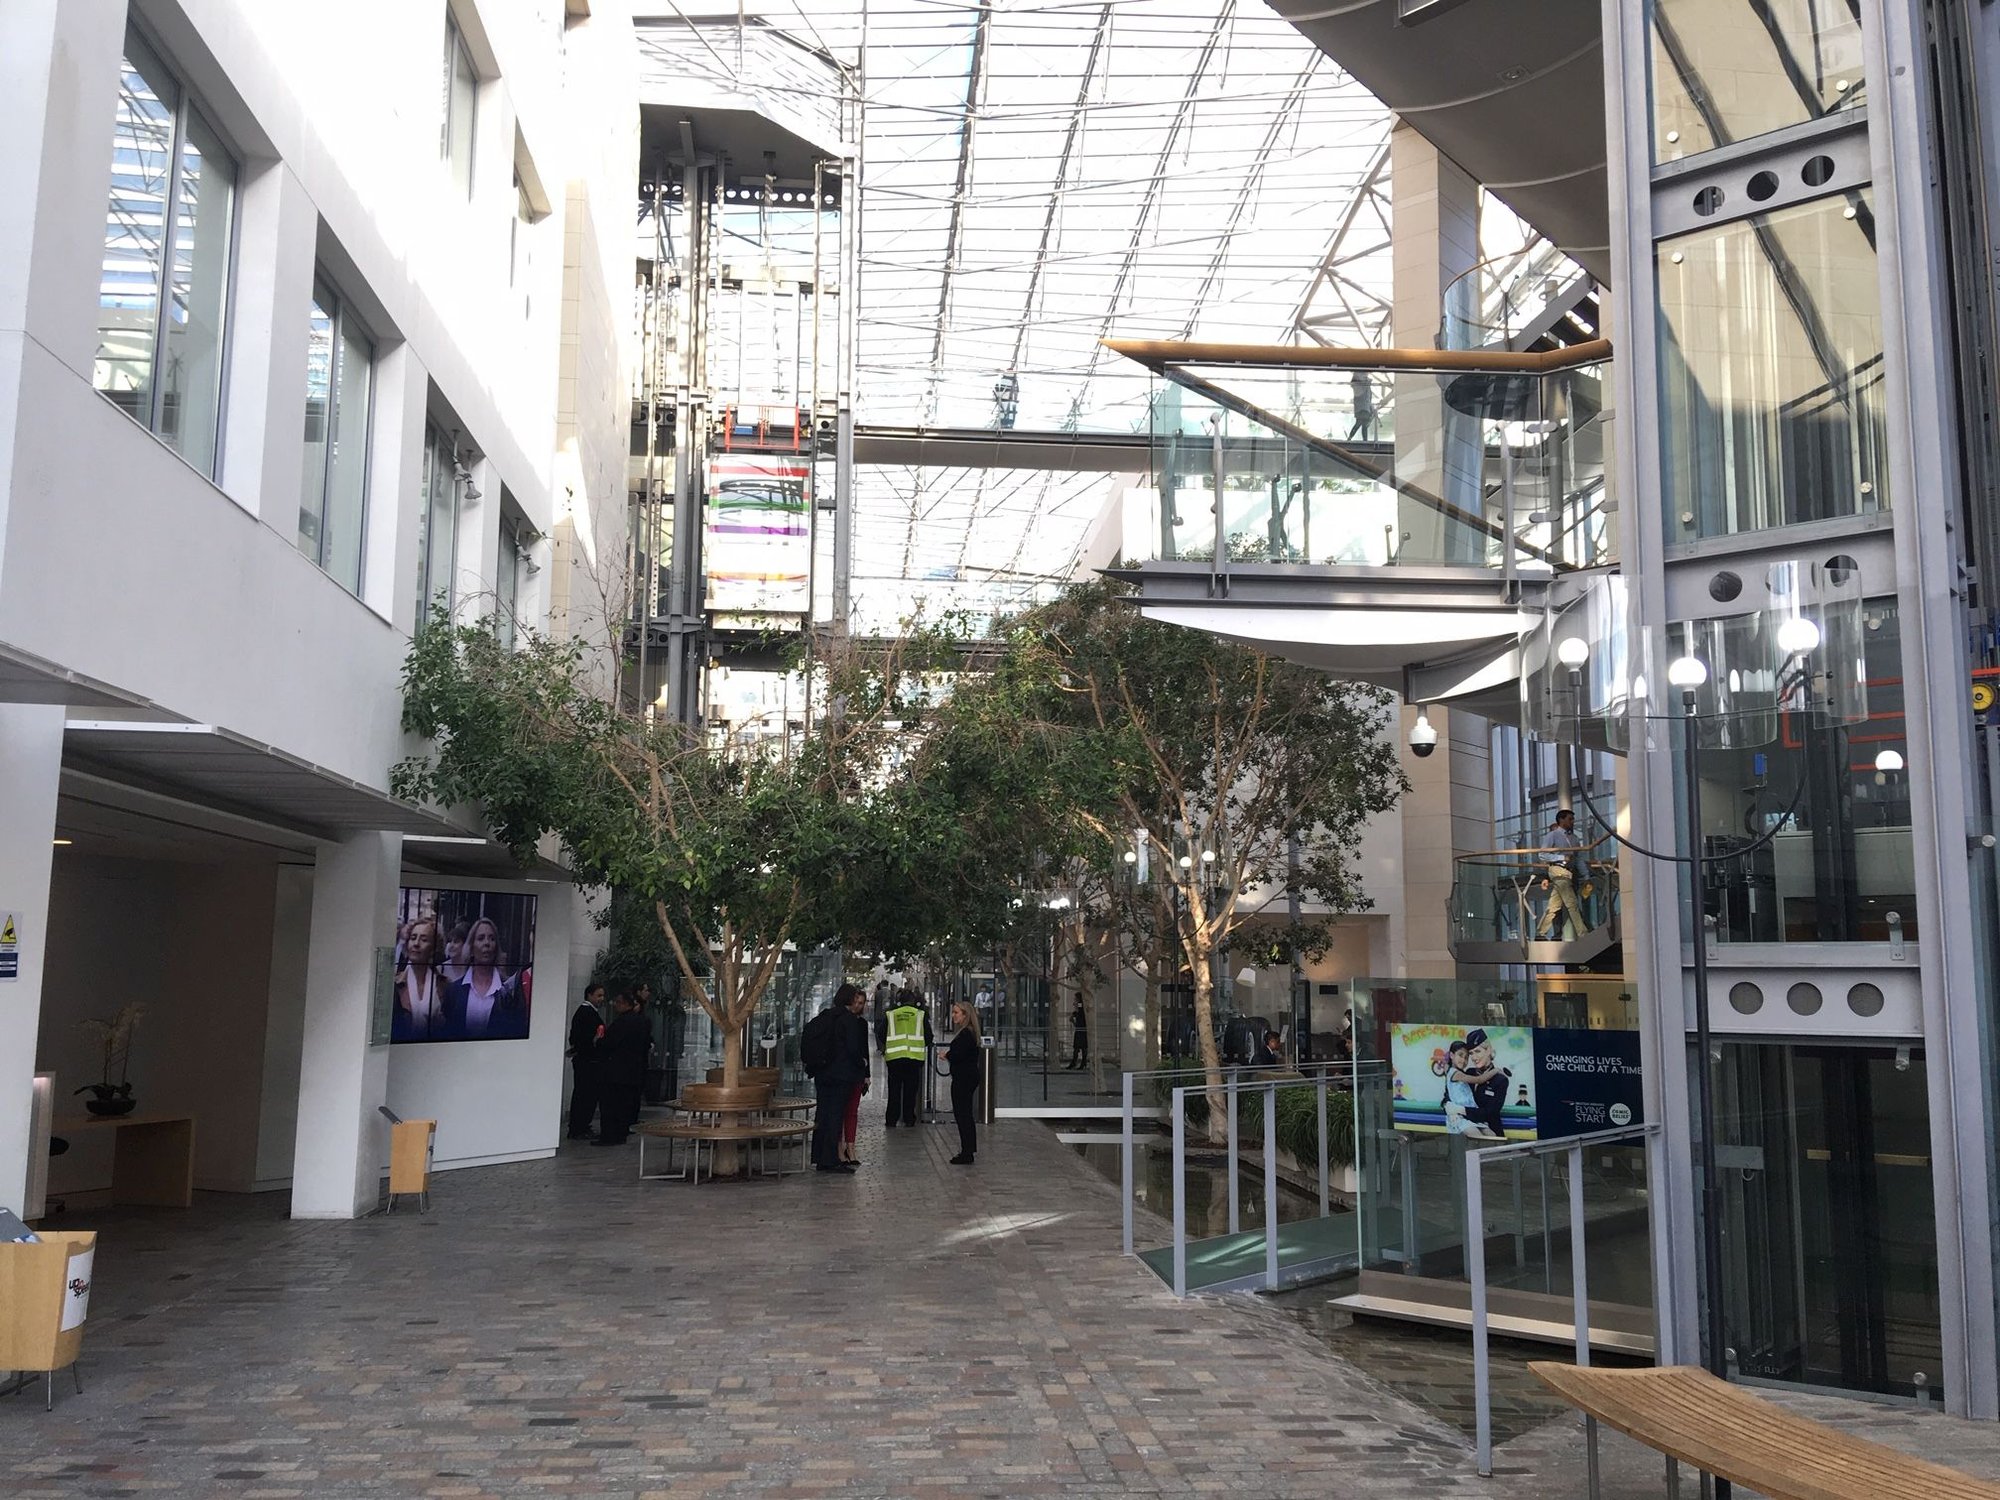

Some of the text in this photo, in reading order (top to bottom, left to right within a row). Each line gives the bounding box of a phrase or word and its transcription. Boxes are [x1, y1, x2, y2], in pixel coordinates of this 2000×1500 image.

[1546, 1054, 1622, 1066] CHANGING LIVES
[1546, 1062, 1566, 1071] ONE
[1567, 1064, 1595, 1072] CHILD
[1597, 1065, 1608, 1073] AT
[1620, 1066, 1642, 1074] TIME
[1575, 1106, 1605, 1115] FLYING
[1575, 1114, 1606, 1124] START
